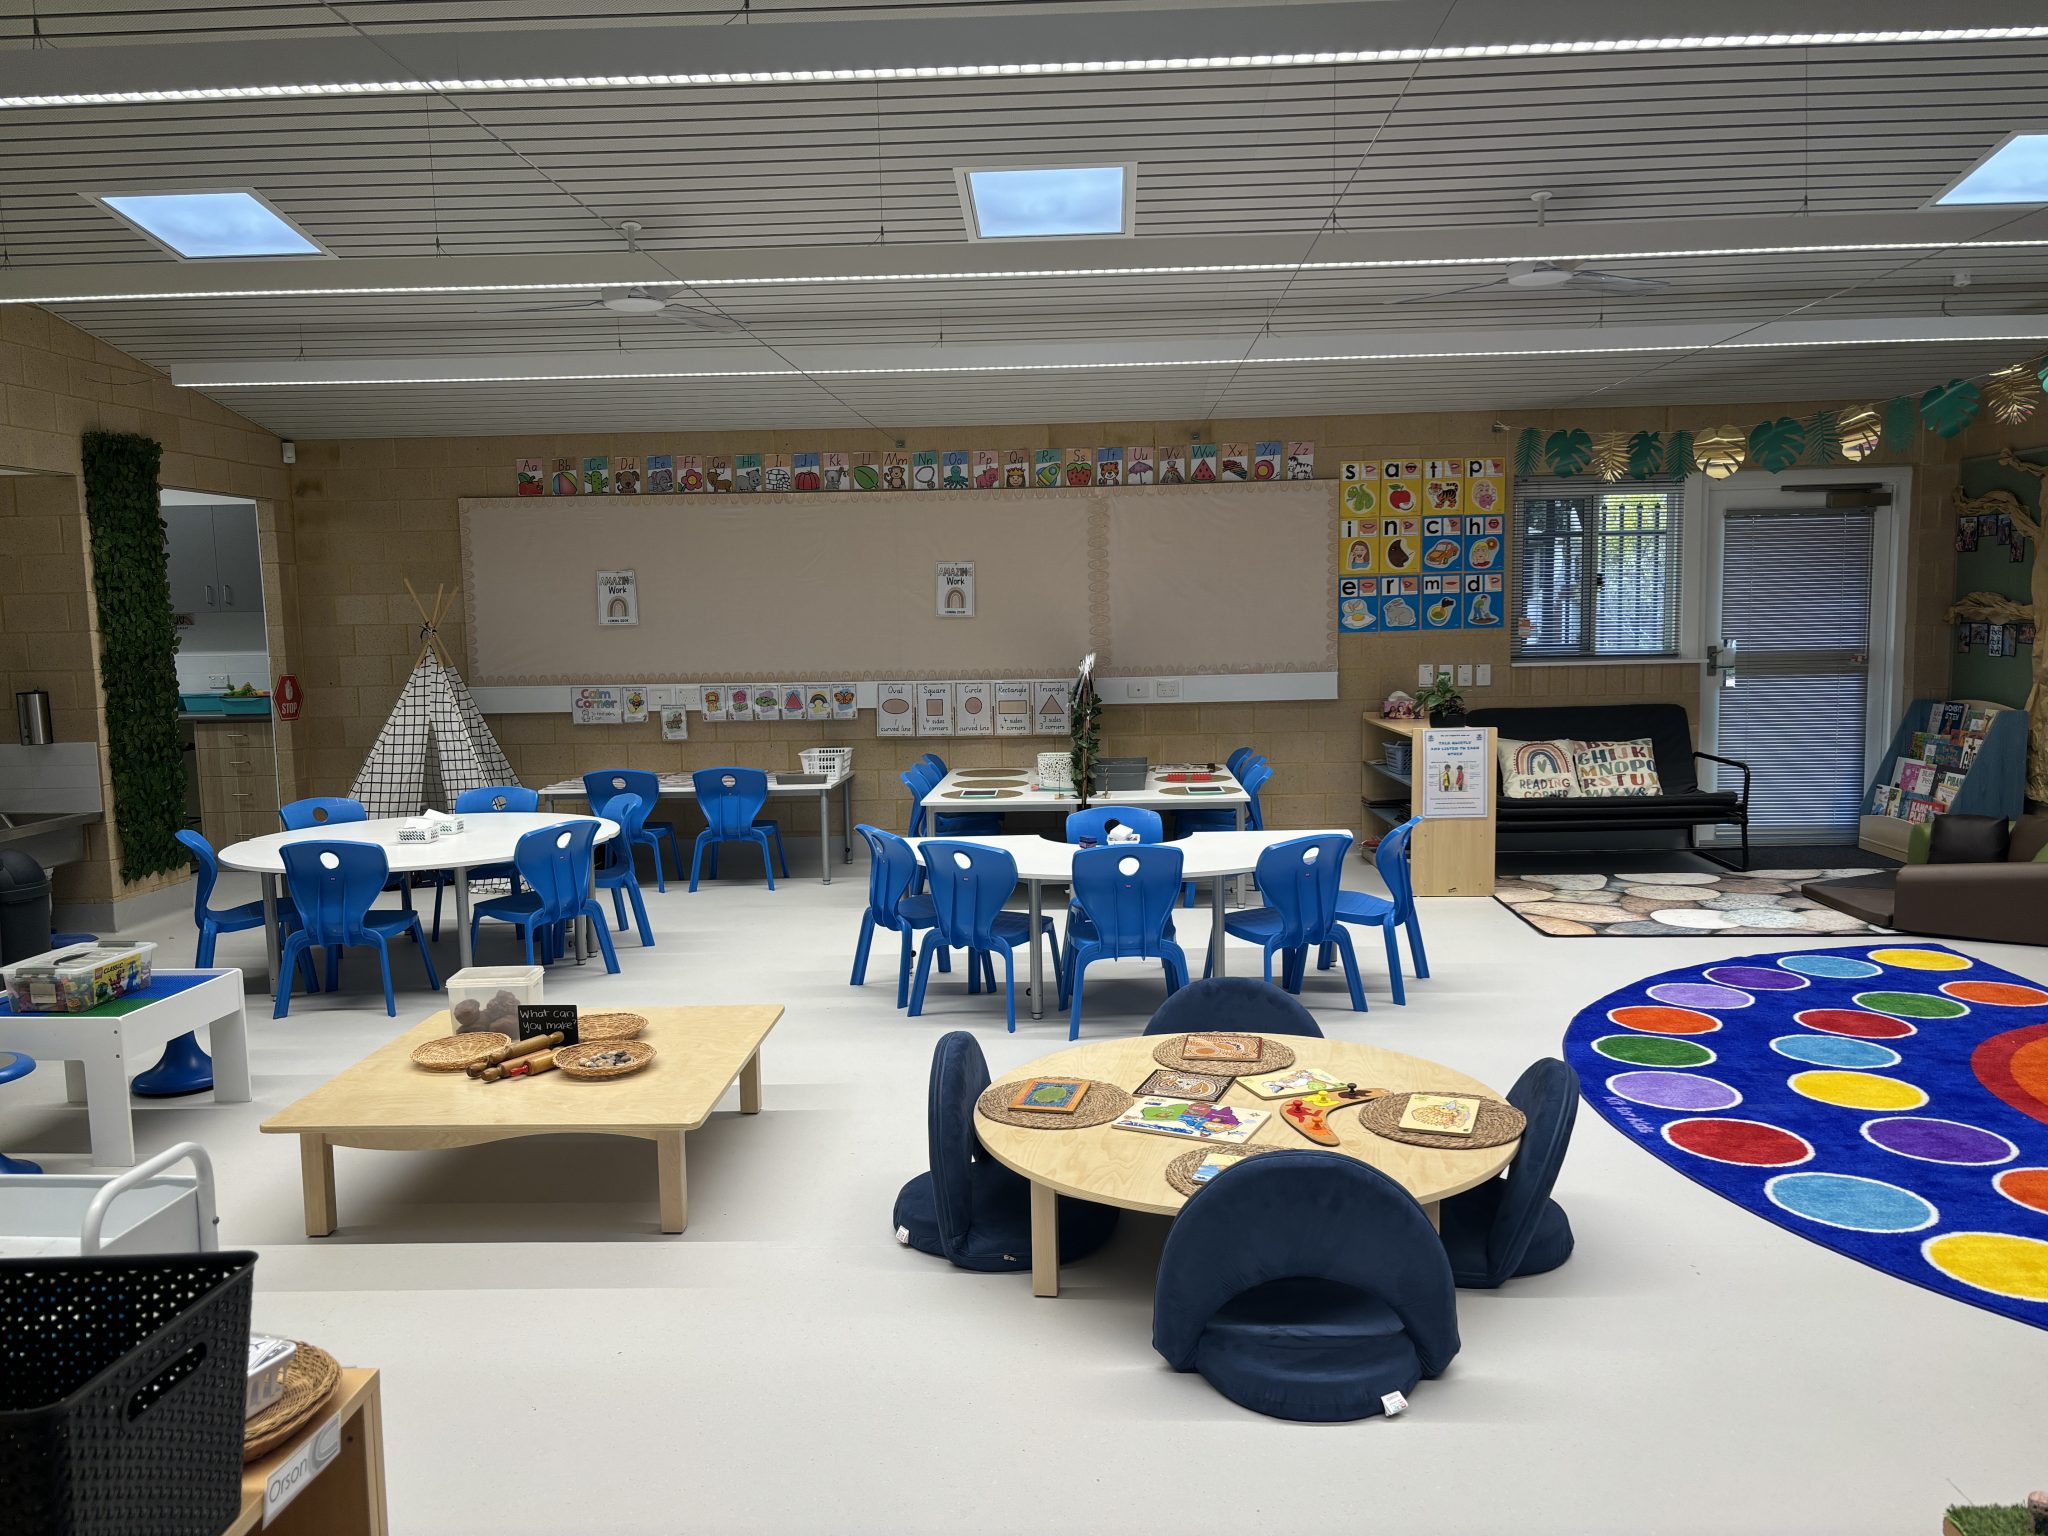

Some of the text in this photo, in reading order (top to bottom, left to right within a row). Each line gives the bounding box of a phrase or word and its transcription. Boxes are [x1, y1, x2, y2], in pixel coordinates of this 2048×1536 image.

[523, 460, 537, 471] Aa
[558, 459, 570, 471] Bb
[589, 459, 602, 470] Cc
[621, 458, 634, 470] Dd
[654, 456, 666, 468] Ee
[683, 456, 696, 469] Ff
[742, 456, 755, 467] Hh
[829, 454, 841, 466] Kk
[884, 453, 908, 465] Mm
[918, 452, 933, 465] Nn
[948, 452, 962, 465] Oo
[1073, 449, 1086, 462] Ss
[1133, 448, 1148, 461] Uu
[1228, 444, 1243, 457] Xx
[1262, 442, 1276, 461] Yy
[1293, 442, 1309, 455] Zz
[1345, 460, 1483, 480] s a t p
[1347, 517, 1481, 538] i n c h
[946, 577, 965, 586] Work
[1342, 575, 1480, 595] e r m d
[608, 586, 627, 594] Work
[580, 688, 612, 699] Calm
[888, 685, 903, 694] Oval
[923, 685, 946, 697] Square
[964, 685, 982, 694] Circle
[998, 685, 1027, 697] Rectangle
[1039, 684, 1065, 695] Triangle
[281, 702, 298, 715] STOP
[575, 697, 618, 709] Corner
[1519, 778, 1571, 790] READING
[1523, 790, 1569, 798] CORNER
[104, 962, 125, 974] CLASSIC
[519, 1009, 575, 1019] What can
[522, 1019, 577, 1034] you make?
[1612, 1106, 1637, 1118] for
[1625, 1117, 1656, 1134] Kids
[268, 1457, 308, 1504] Orson
